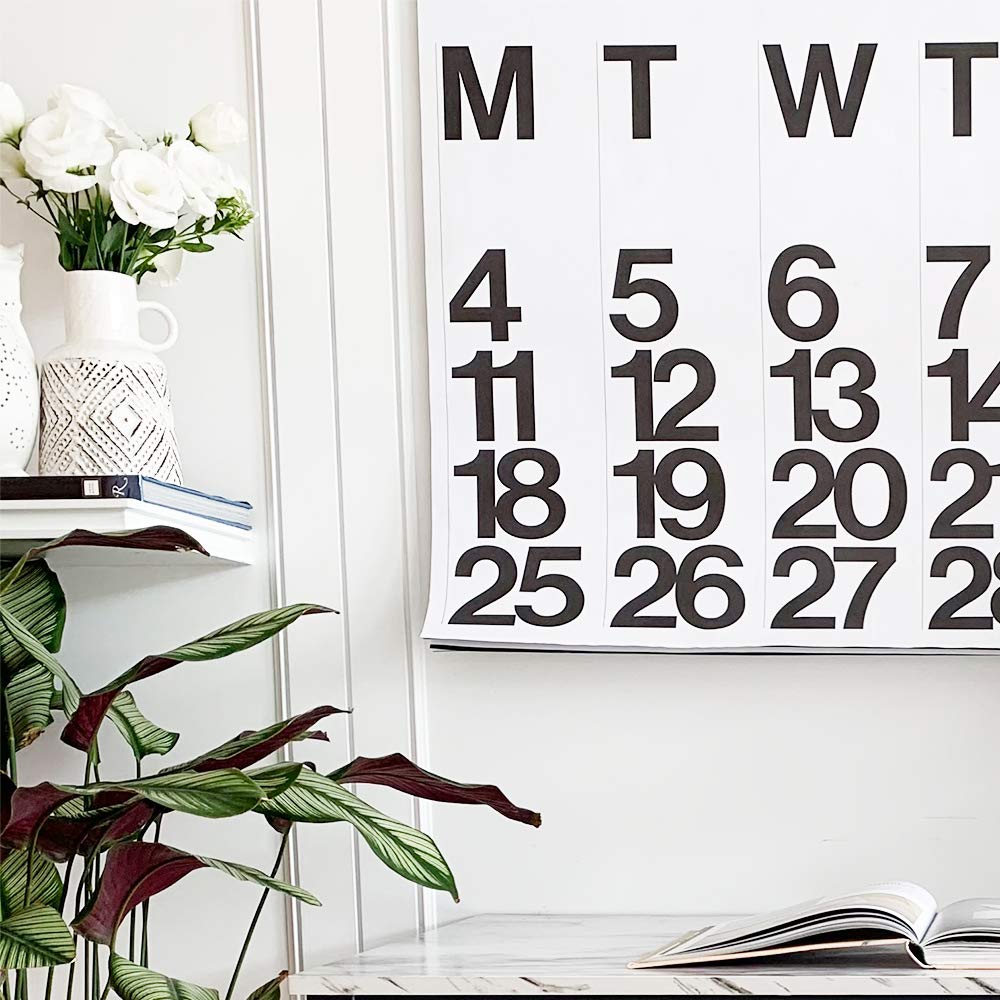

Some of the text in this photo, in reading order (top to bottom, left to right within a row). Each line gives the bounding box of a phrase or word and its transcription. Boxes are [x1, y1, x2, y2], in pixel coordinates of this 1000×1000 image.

[442, 46, 534, 140] M
[604, 45, 677, 139] T
[763, 44, 878, 137] W
[925, 42, 998, 136] T
[449, 249, 522, 341] 4
[609, 249, 678, 342] 5
[768, 244, 839, 342] 6
[926, 246, 990, 339] 7
[452, 351, 535, 441] 11
[611, 348, 719, 441] 12
[770, 347, 879, 442] 13
[454, 448, 566, 539] 18
[613, 448, 725, 540] 19
[772, 448, 907, 541] 20
[454, 545, 584, 628] 25
[610, 545, 745, 629] 26
[770, 546, 896, 629] 27
